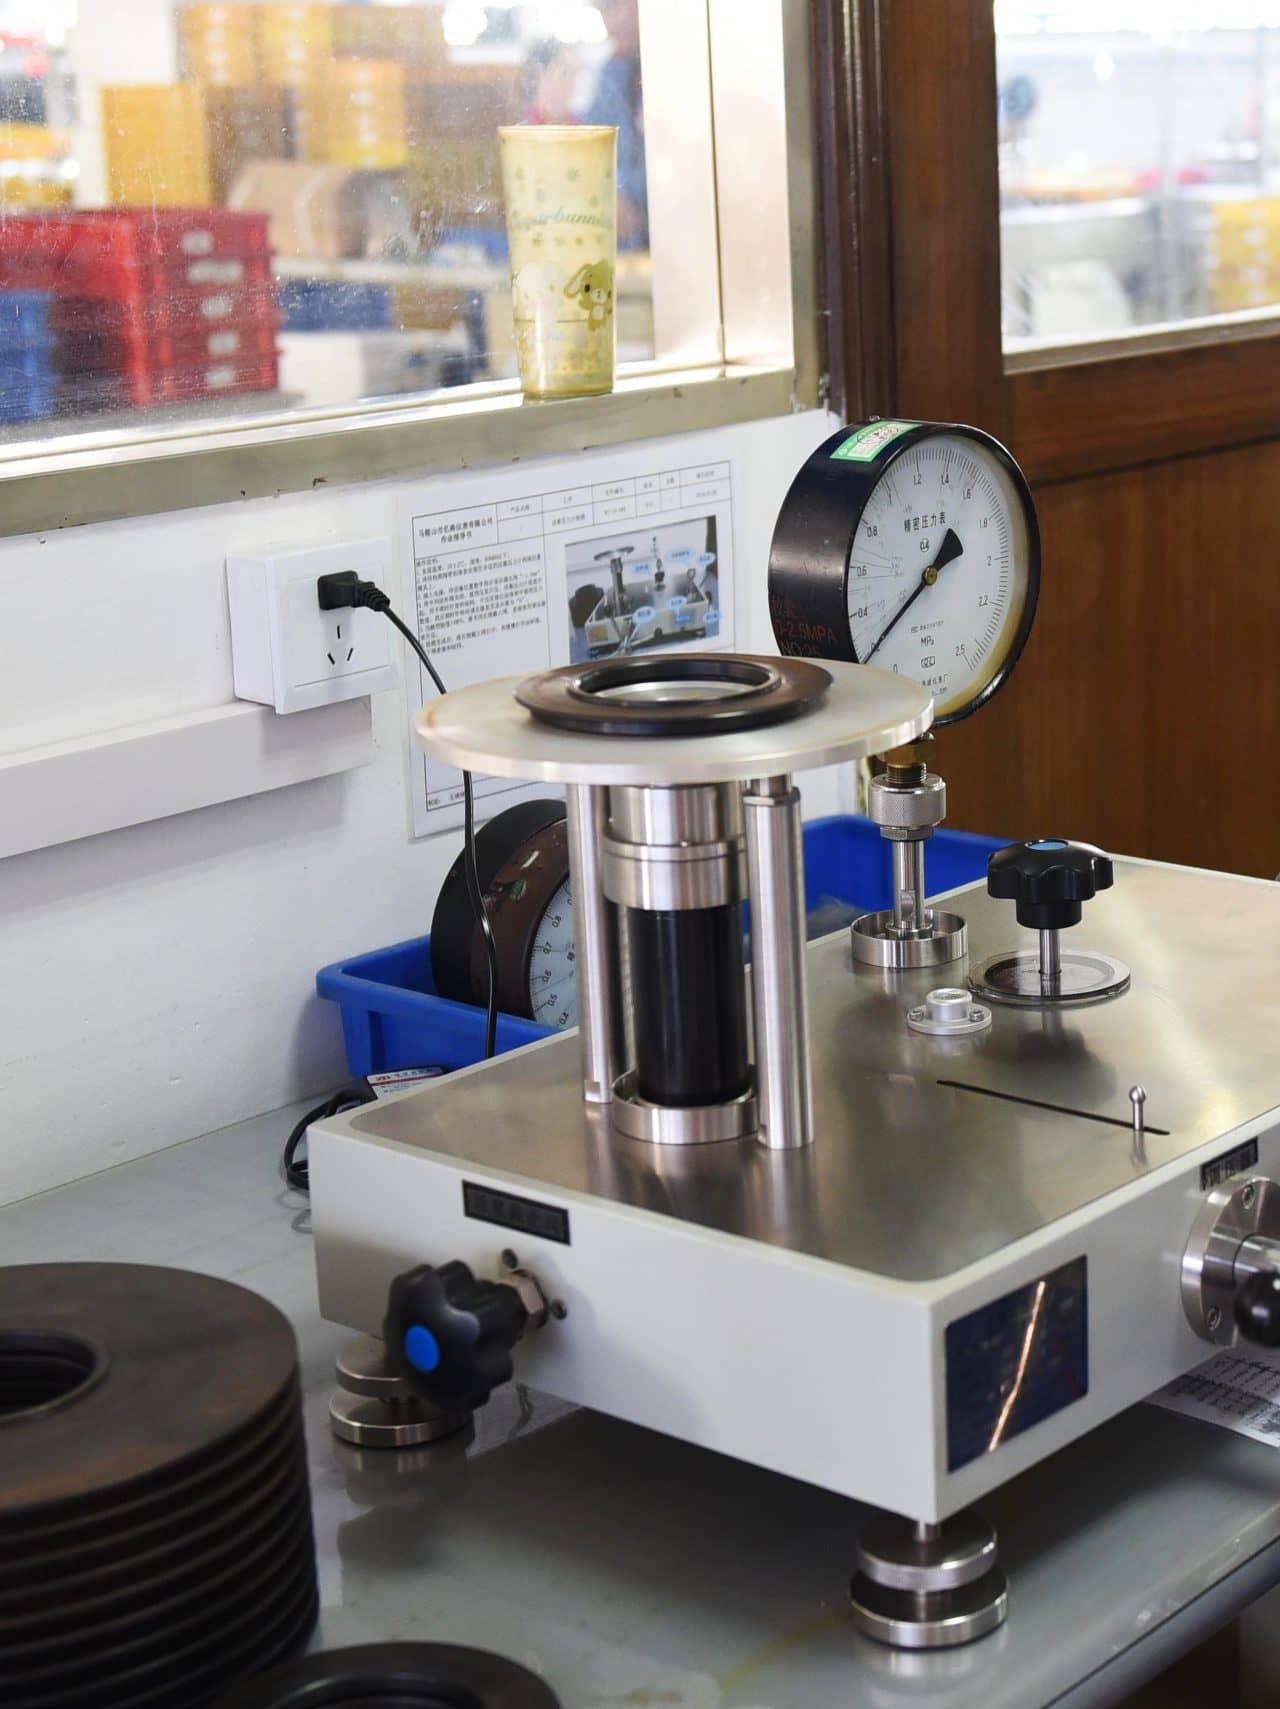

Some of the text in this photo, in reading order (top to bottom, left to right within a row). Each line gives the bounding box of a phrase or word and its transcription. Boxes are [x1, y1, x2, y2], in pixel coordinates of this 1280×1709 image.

[904, 512, 946, 532] 精密压力表
[867, 526, 877, 537] 0.8
[857, 565, 867, 576] 0.6
[858, 607, 867, 618] 0.4
[955, 645, 965, 657] 2.5
